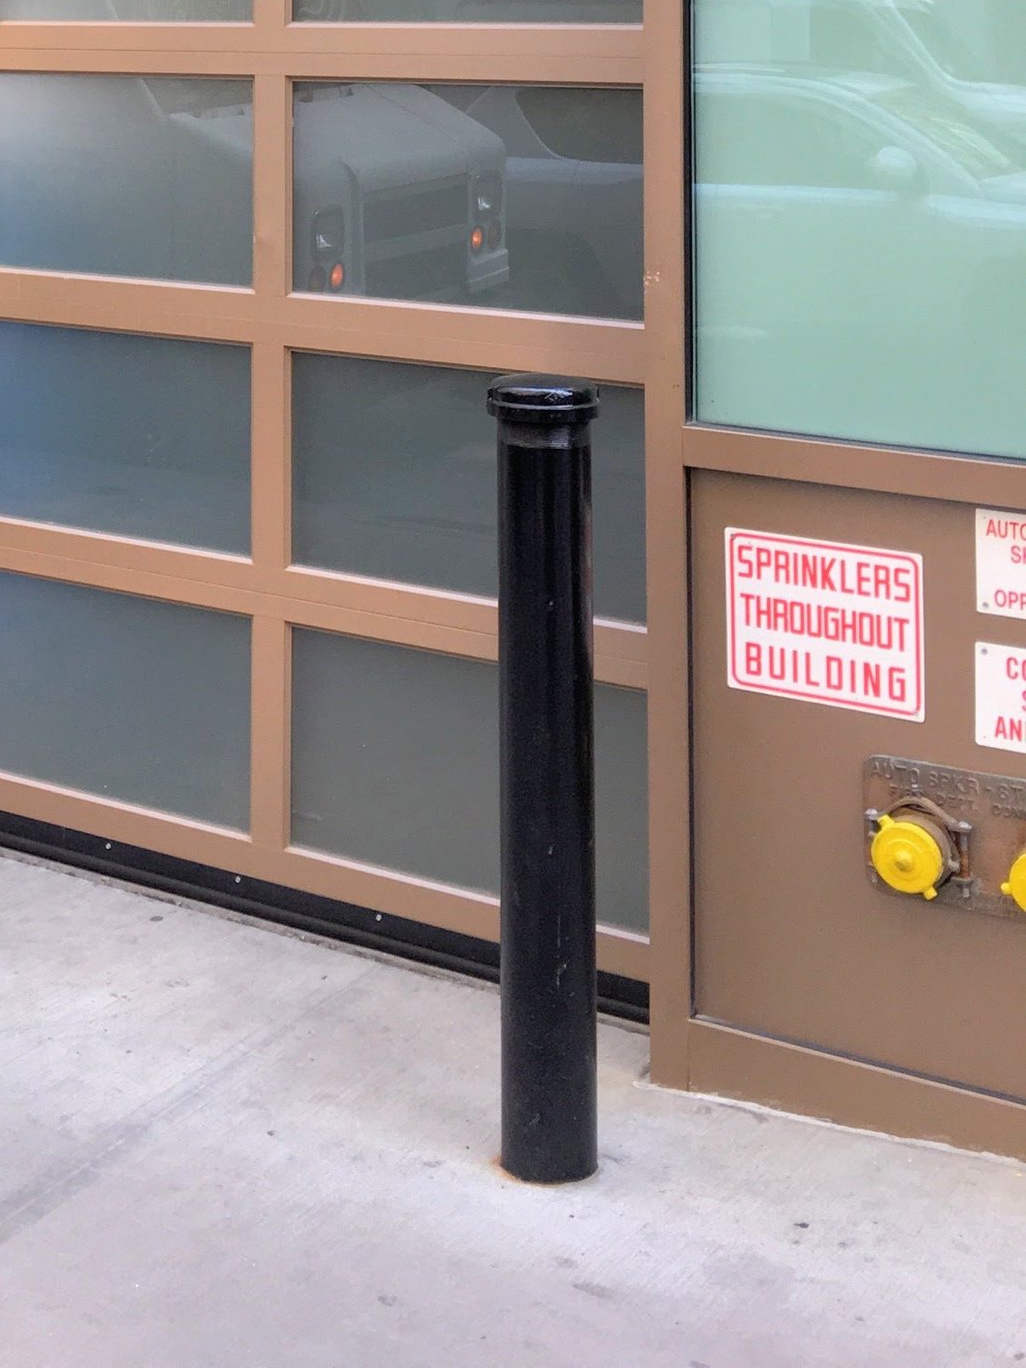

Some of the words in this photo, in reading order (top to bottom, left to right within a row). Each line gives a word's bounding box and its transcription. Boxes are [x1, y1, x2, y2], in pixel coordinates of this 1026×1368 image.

[737, 544, 911, 603] SPRINKLERS
[739, 592, 910, 652] THROUGHOUT
[745, 642, 906, 703] BUILDING
